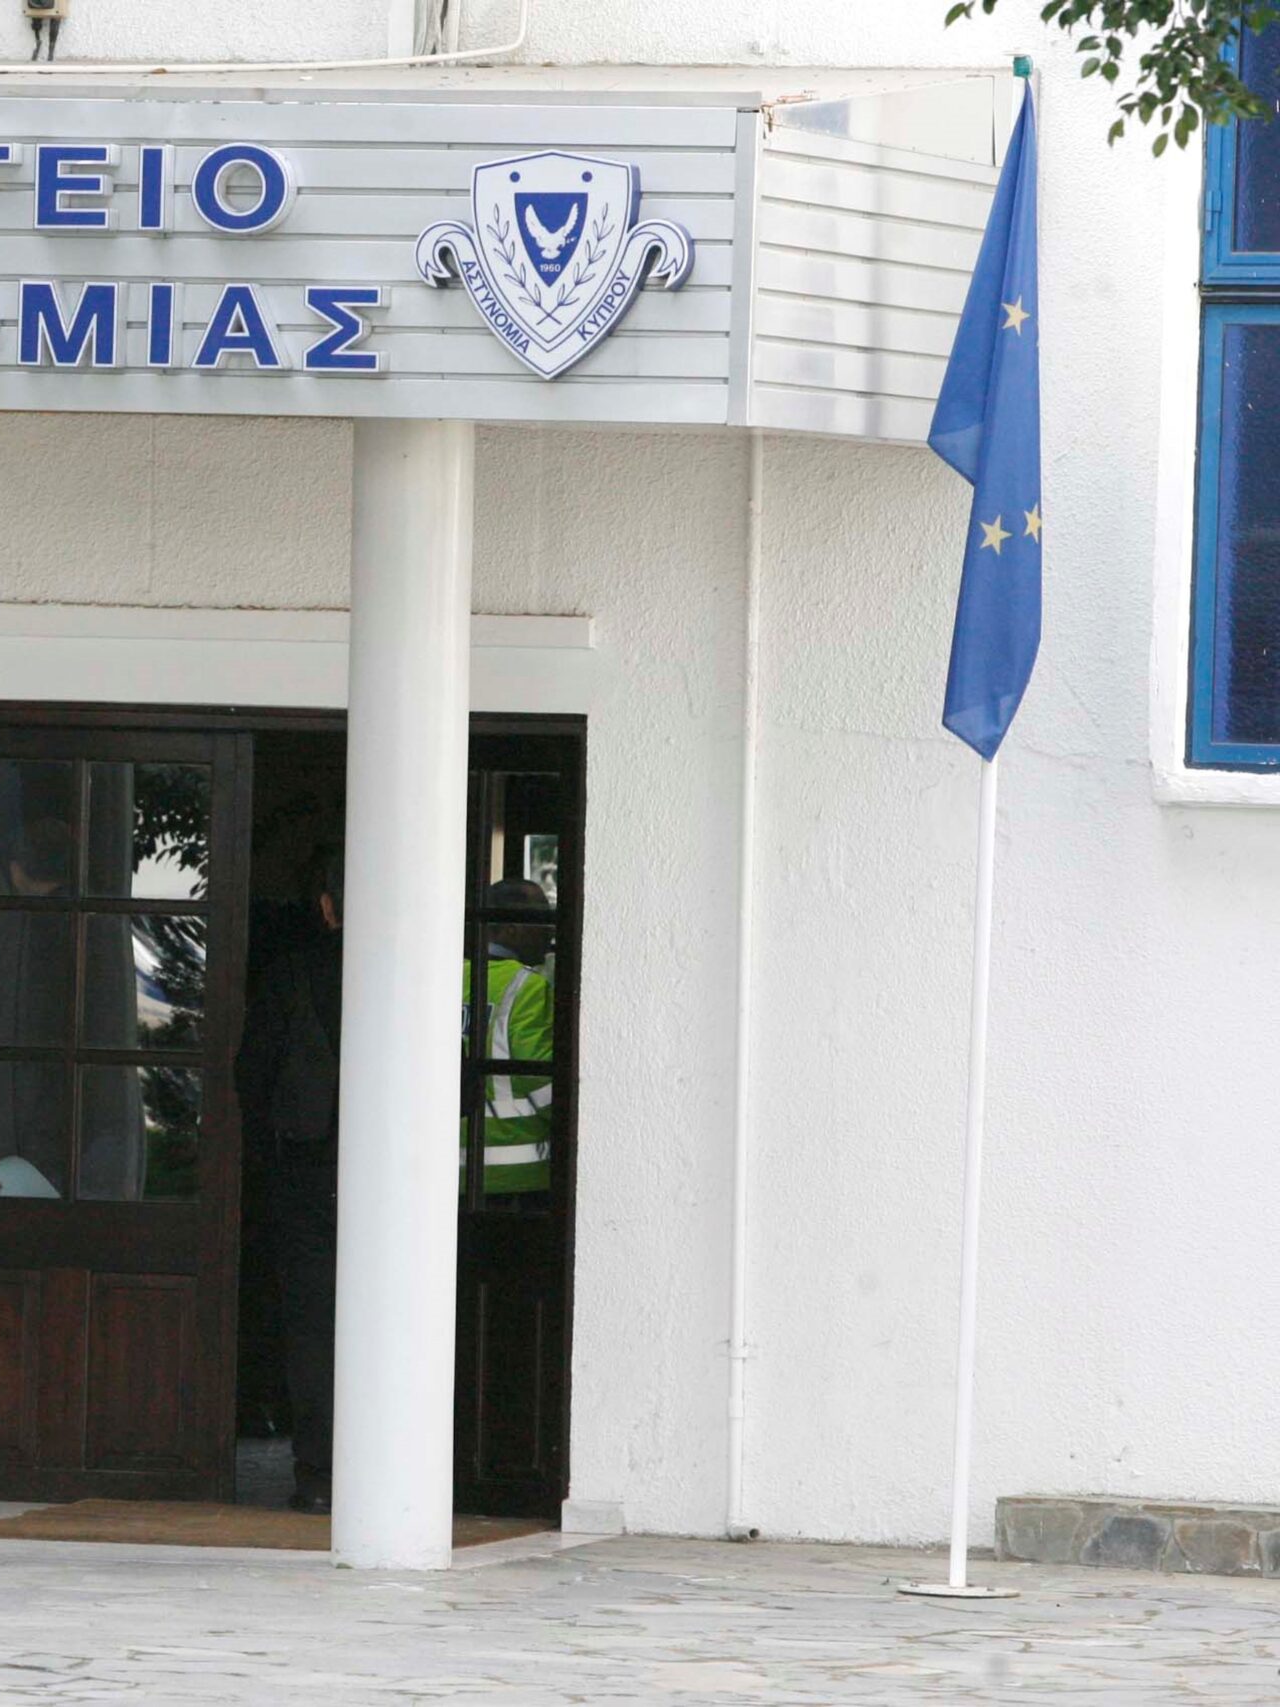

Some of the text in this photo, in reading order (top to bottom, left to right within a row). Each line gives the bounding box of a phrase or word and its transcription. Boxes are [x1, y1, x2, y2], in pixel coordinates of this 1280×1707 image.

[539, 263, 561, 273] 1960
[461, 259, 632, 354] ΑΣΤΥΝΟΜΙΑ ΚΥΠΡΟΥ
